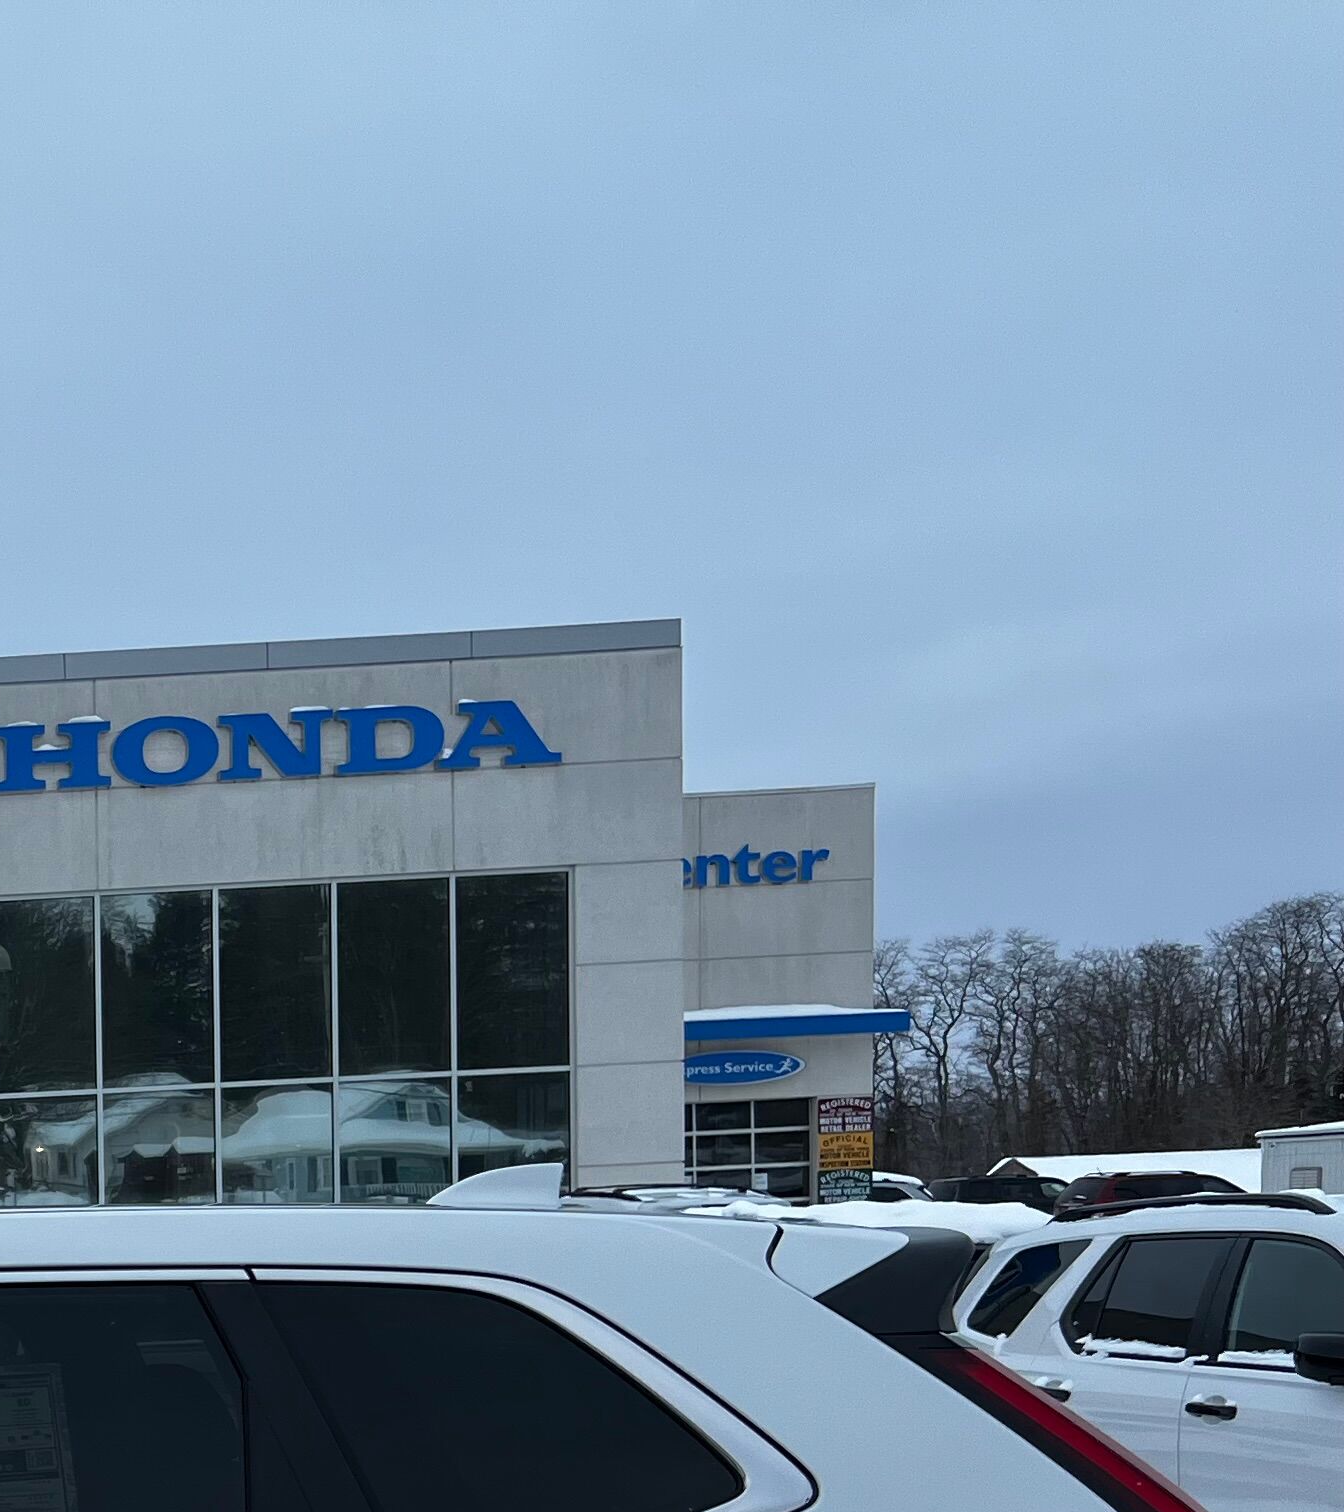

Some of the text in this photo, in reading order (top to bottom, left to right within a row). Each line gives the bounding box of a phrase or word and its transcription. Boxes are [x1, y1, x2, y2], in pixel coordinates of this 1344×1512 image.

[683, 843, 830, 888] nter
[724, 1061, 774, 1074] Service
[820, 1099, 871, 1112] REGISTERED
[823, 1134, 868, 1147] OFFICIAL
[843, 1150, 869, 1159] VEHICLE
[820, 1169, 870, 1184] REGISTERED
[843, 1187, 870, 1195] VEHICLE
